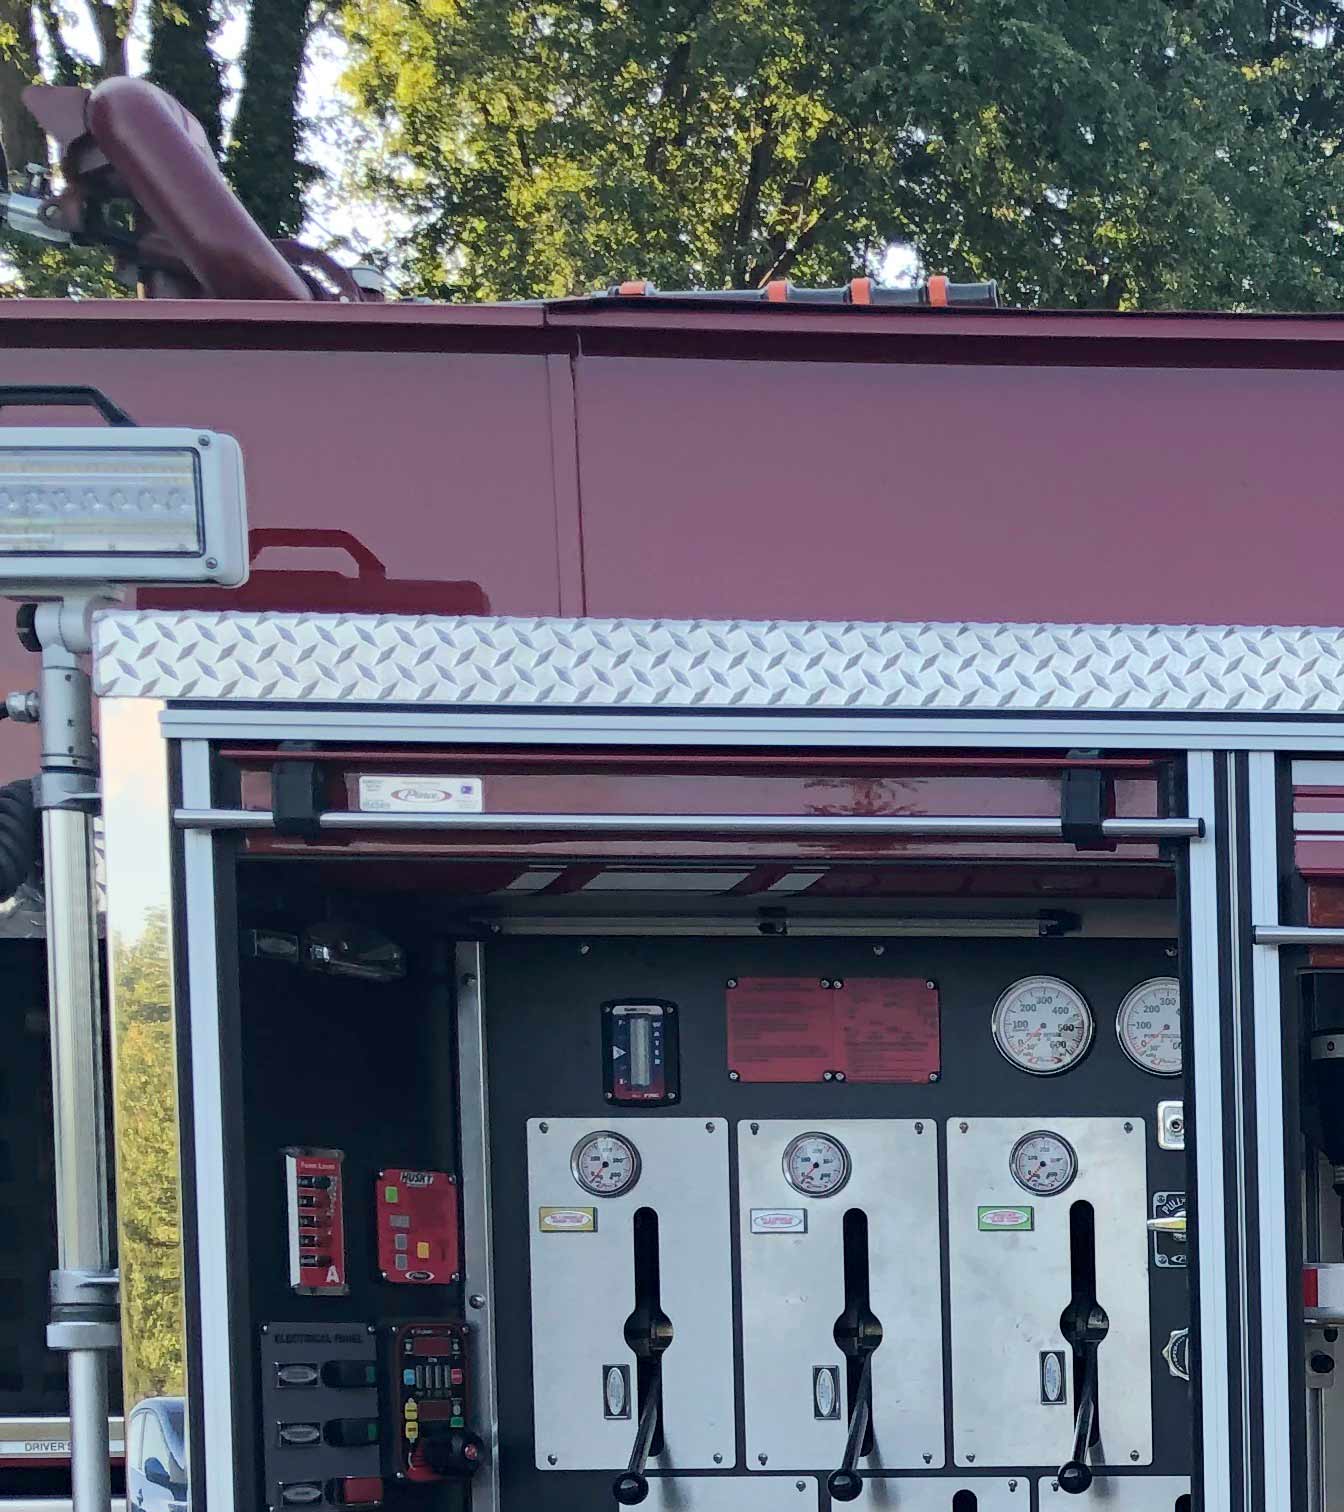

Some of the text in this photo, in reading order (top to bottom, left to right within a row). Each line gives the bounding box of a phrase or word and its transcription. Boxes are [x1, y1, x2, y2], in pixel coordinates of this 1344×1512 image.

[1036, 996, 1053, 1004] 300
[1020, 1004, 1037, 1012] 200
[1052, 1006, 1069, 1014] 400
[1143, 1005, 1160, 1013] 200
[1012, 1020, 1028, 1029] 100
[1057, 1024, 1075, 1032] 500
[1136, 1021, 1152, 1029] 100
[1141, 1040, 1147, 1048] 0
[326, 1265, 340, 1283] A
